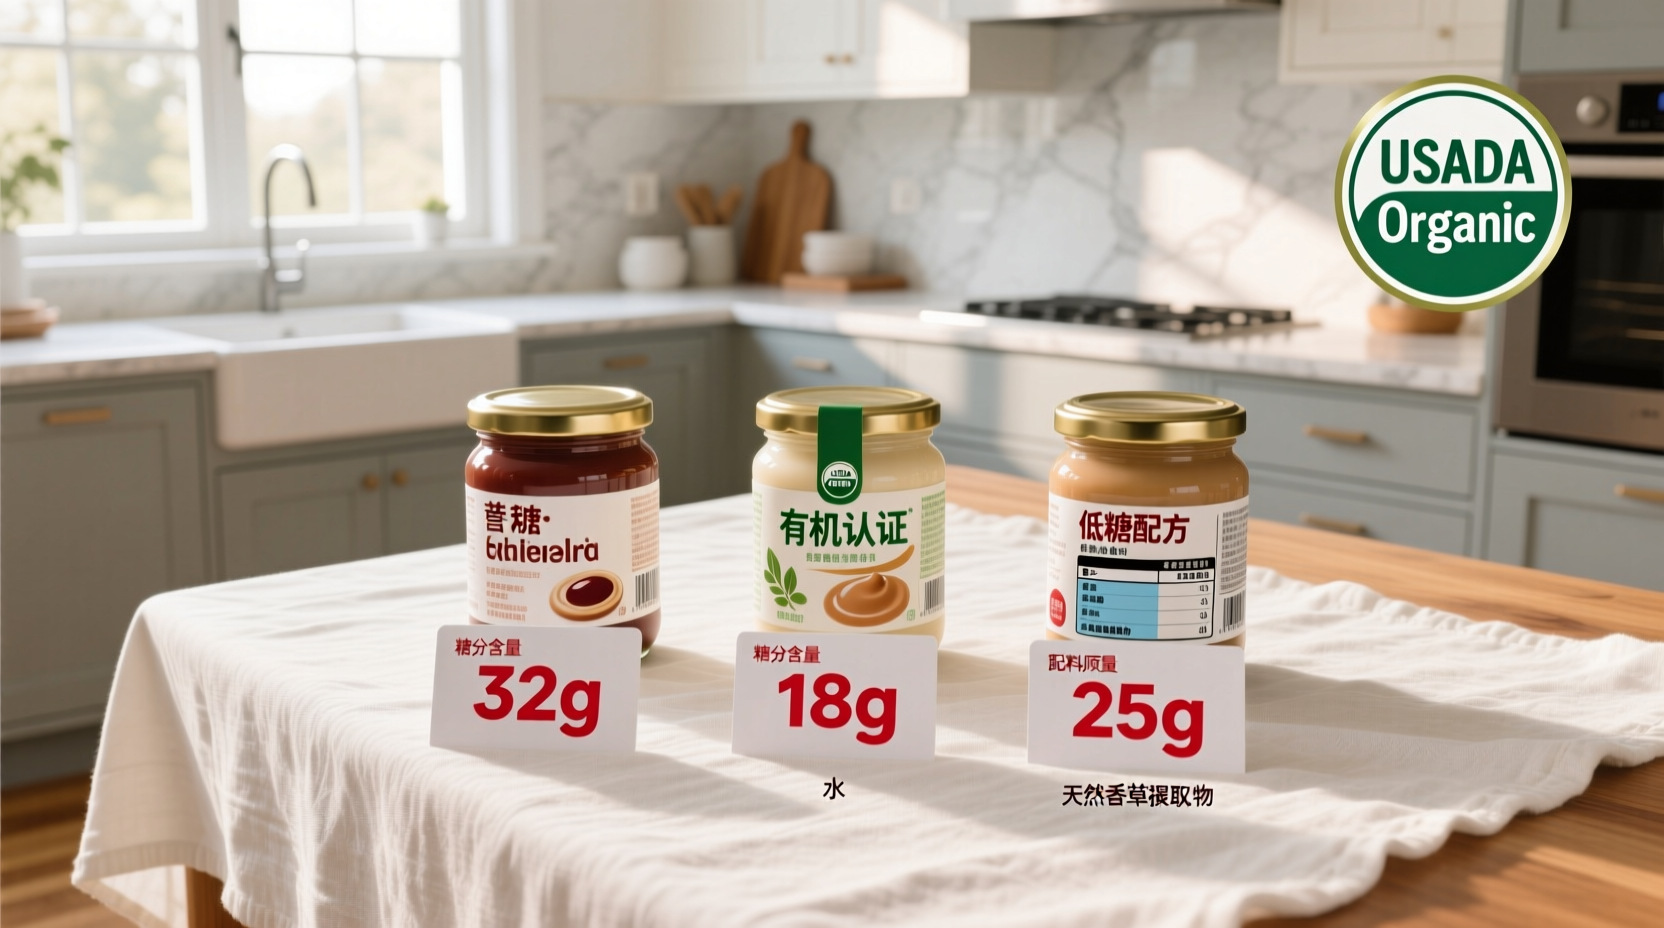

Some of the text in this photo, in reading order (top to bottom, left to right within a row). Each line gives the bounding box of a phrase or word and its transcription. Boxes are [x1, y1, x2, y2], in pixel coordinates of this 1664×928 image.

[779, 508, 909, 547] 有机认证
[1079, 509, 1190, 544] 低糖配方
[473, 665, 602, 737] 32g
[778, 673, 897, 745] 18g
[1072, 681, 1204, 758] 25g
